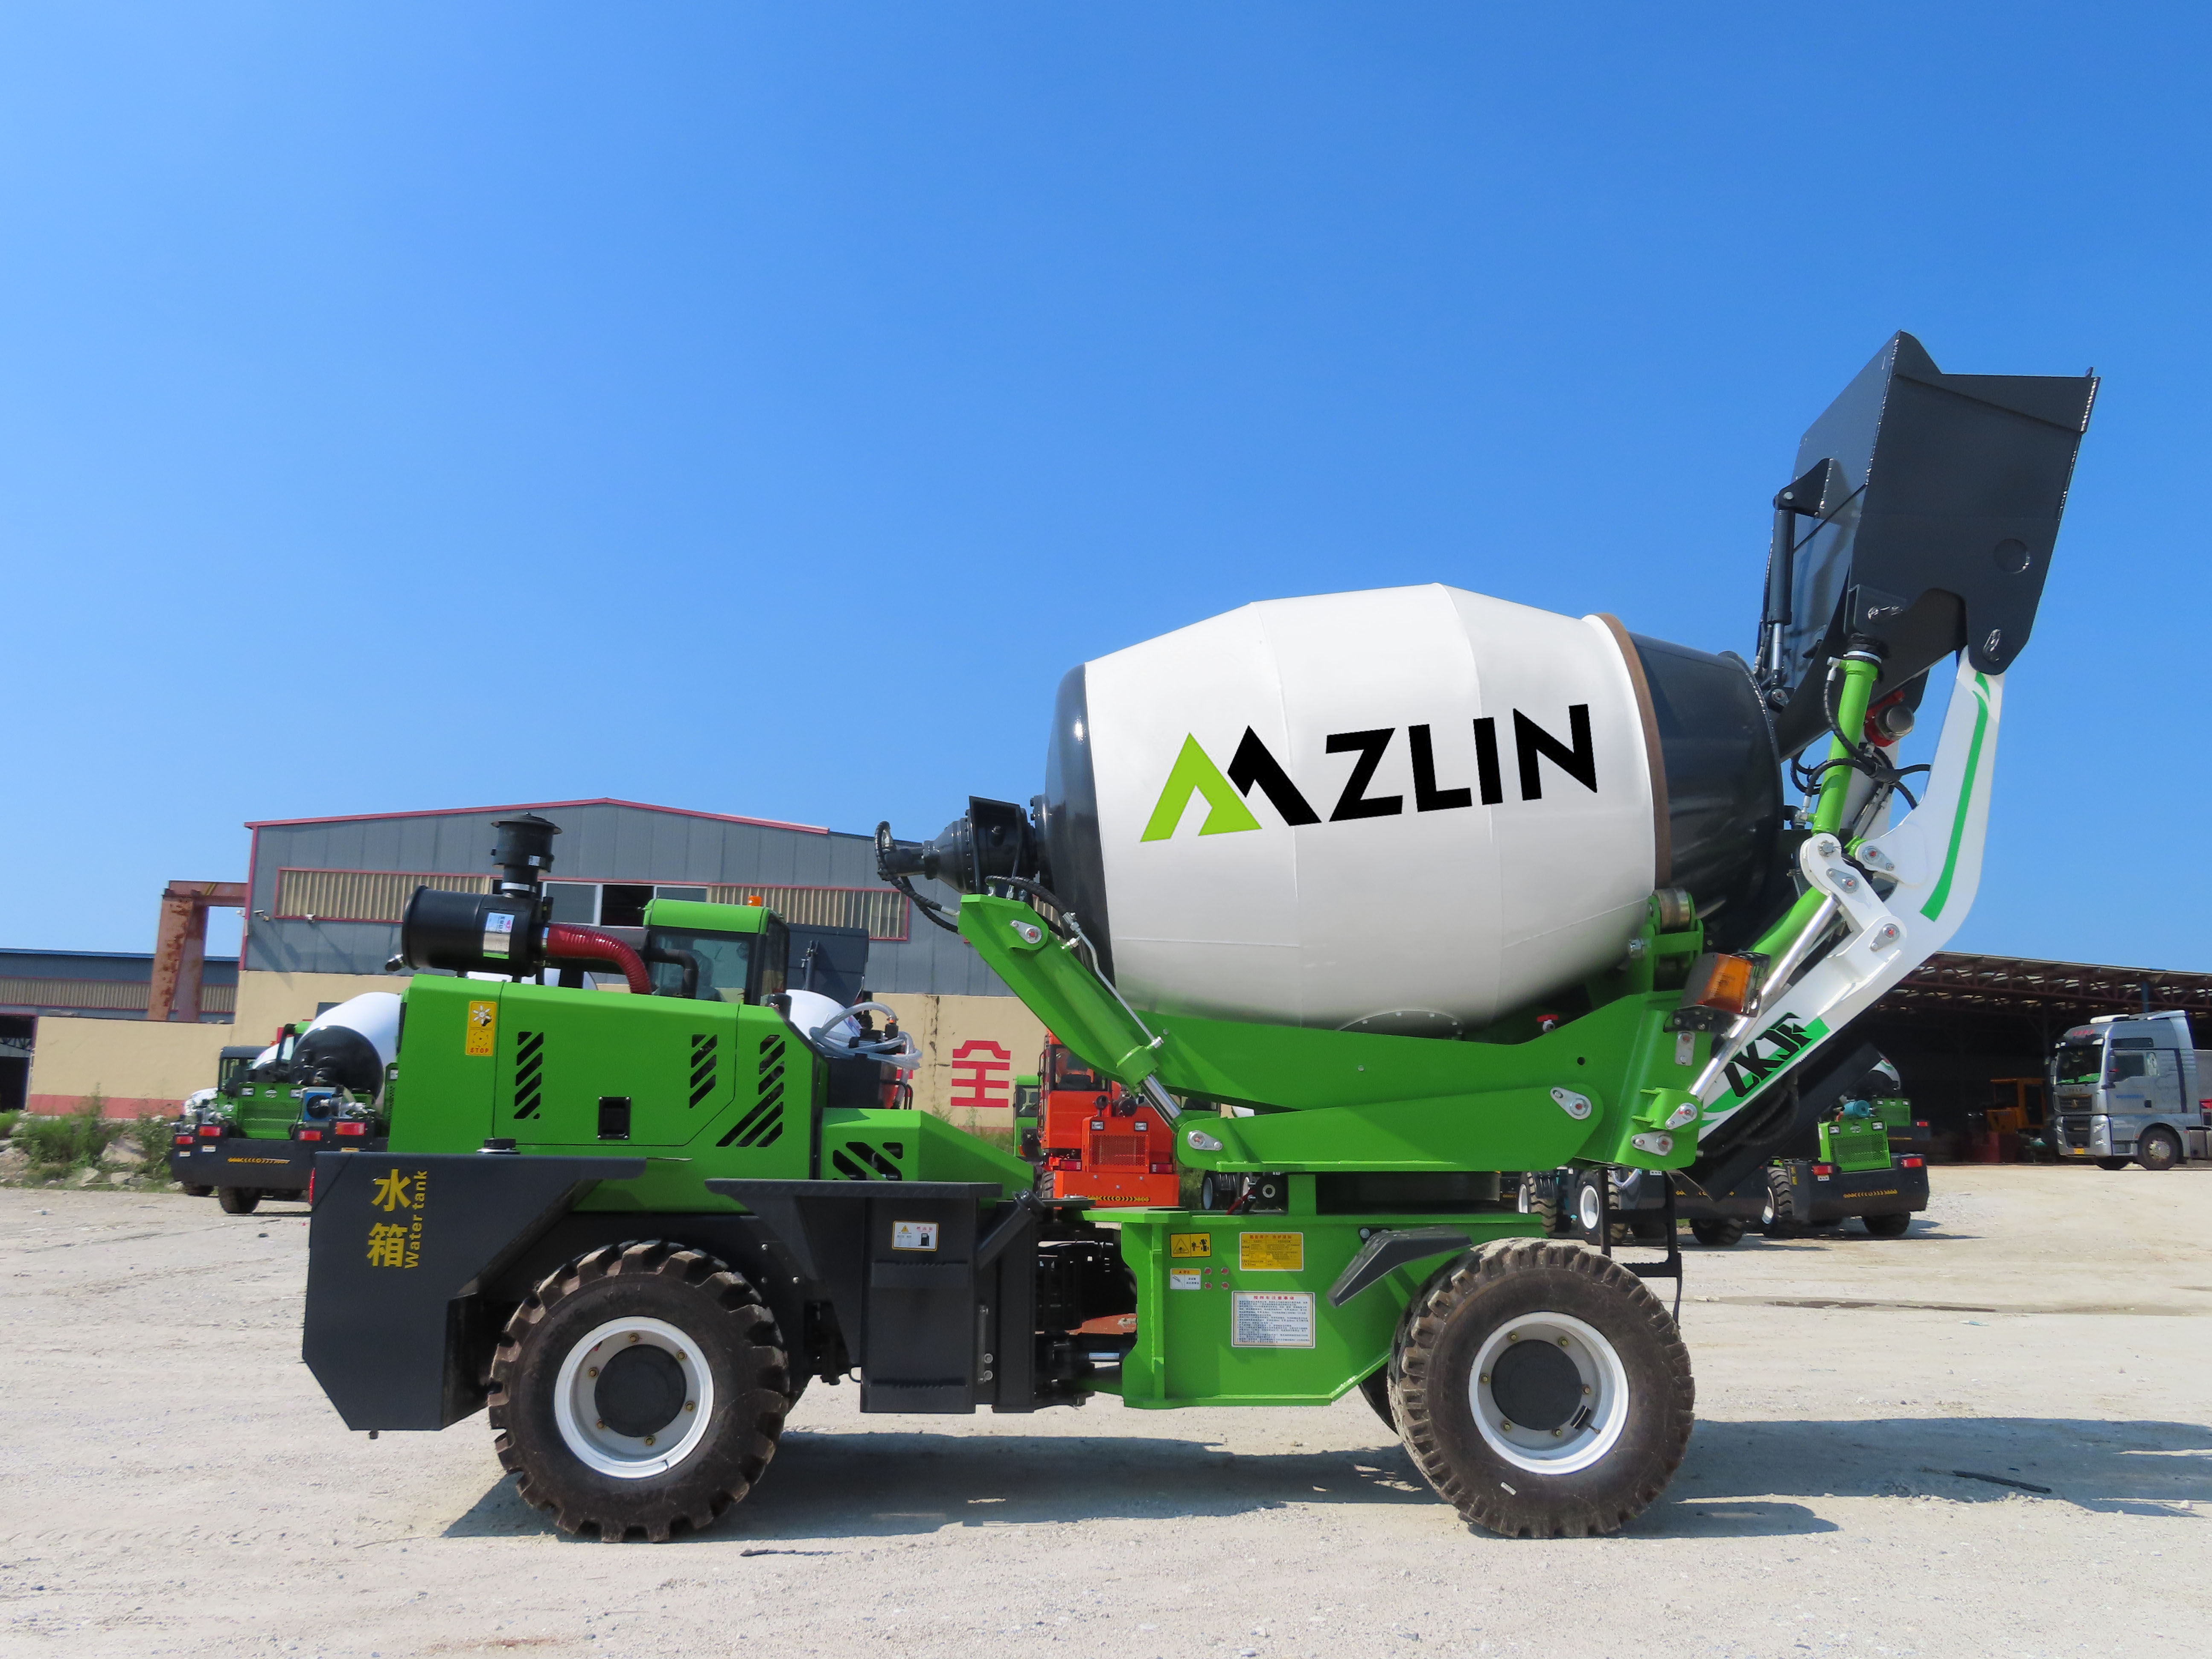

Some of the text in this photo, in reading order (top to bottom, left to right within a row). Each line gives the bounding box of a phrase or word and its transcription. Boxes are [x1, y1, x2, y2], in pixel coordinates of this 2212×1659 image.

[951, 1040, 1011, 1108] 全
[367, 1169, 411, 1267] 水箱
[405, 1170, 428, 1269] Water tank
